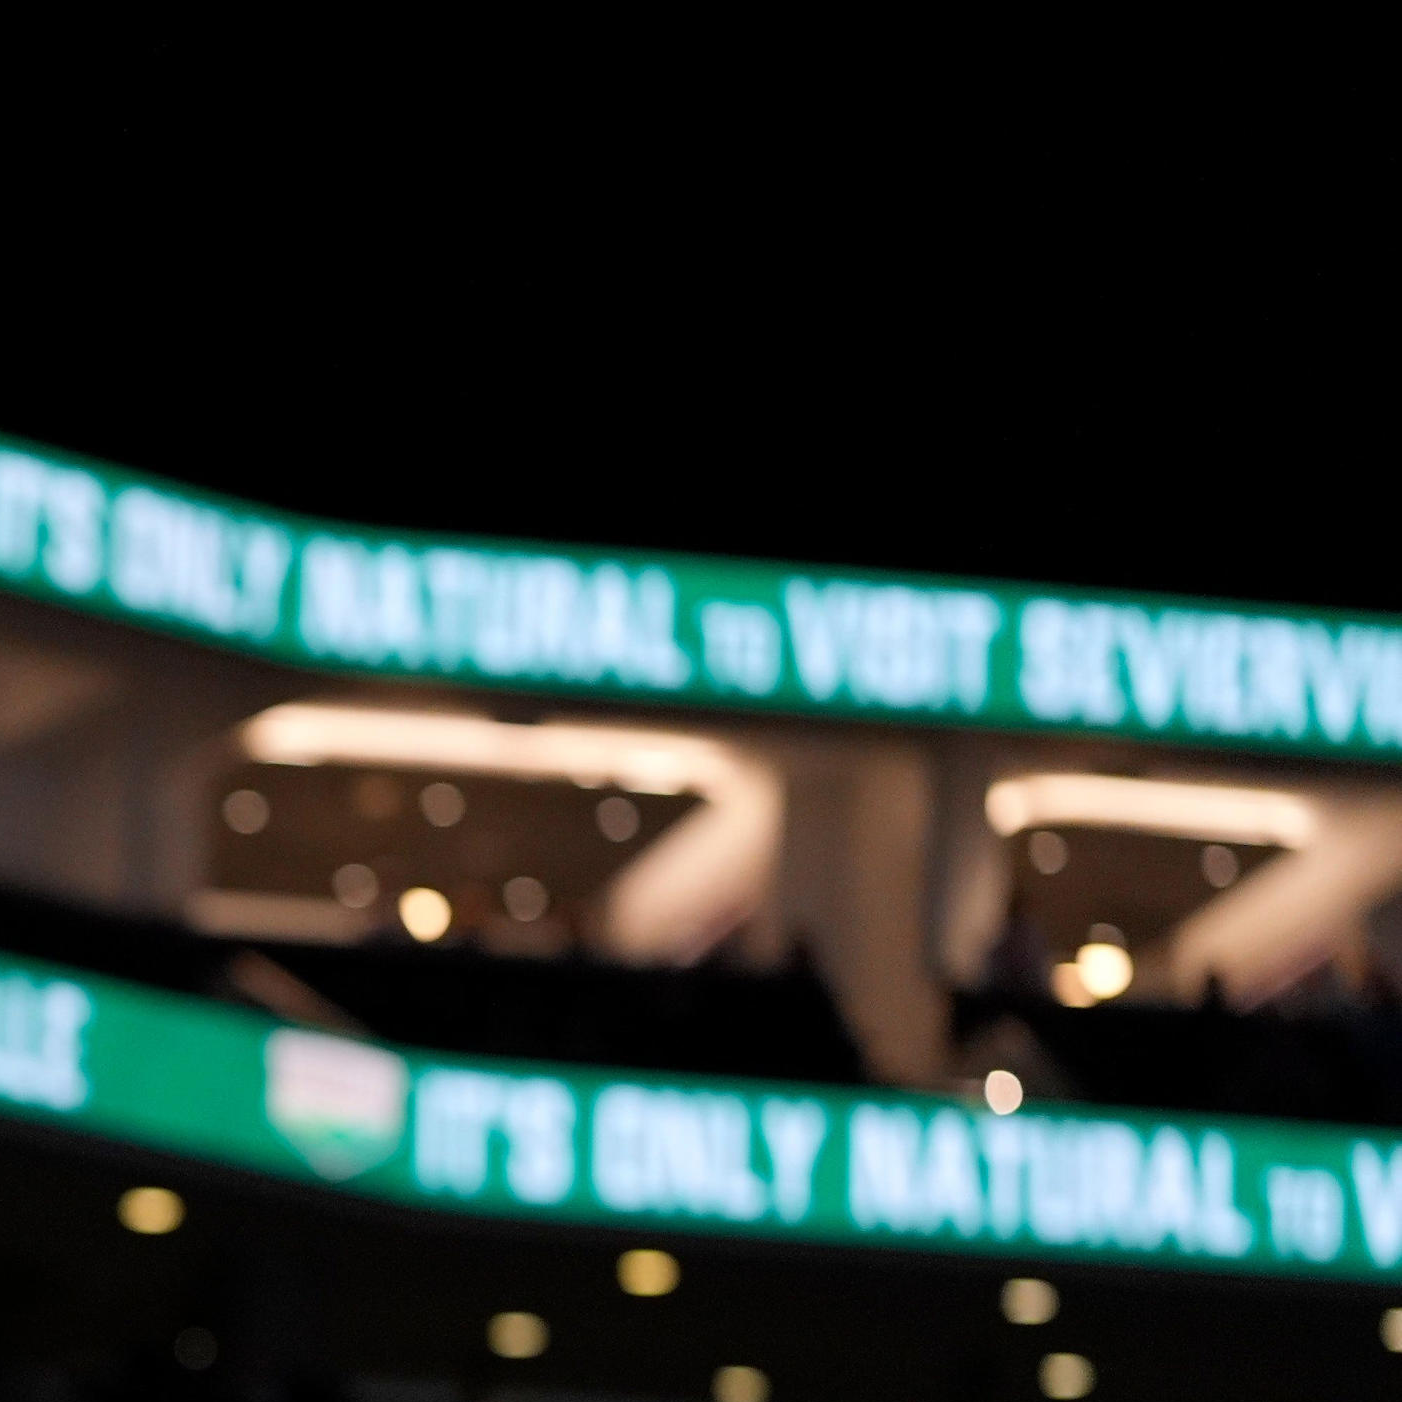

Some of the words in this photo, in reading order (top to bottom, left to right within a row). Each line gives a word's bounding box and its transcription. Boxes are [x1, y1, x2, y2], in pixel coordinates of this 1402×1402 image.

[106, 486, 293, 643] ONLY
[298, 535, 693, 690] NATURAL
[782, 575, 1000, 714] VISIT
[413, 1065, 578, 1207] IT'S
[590, 1083, 828, 1228] ONLY
[847, 1101, 1255, 1259] NATURAL
